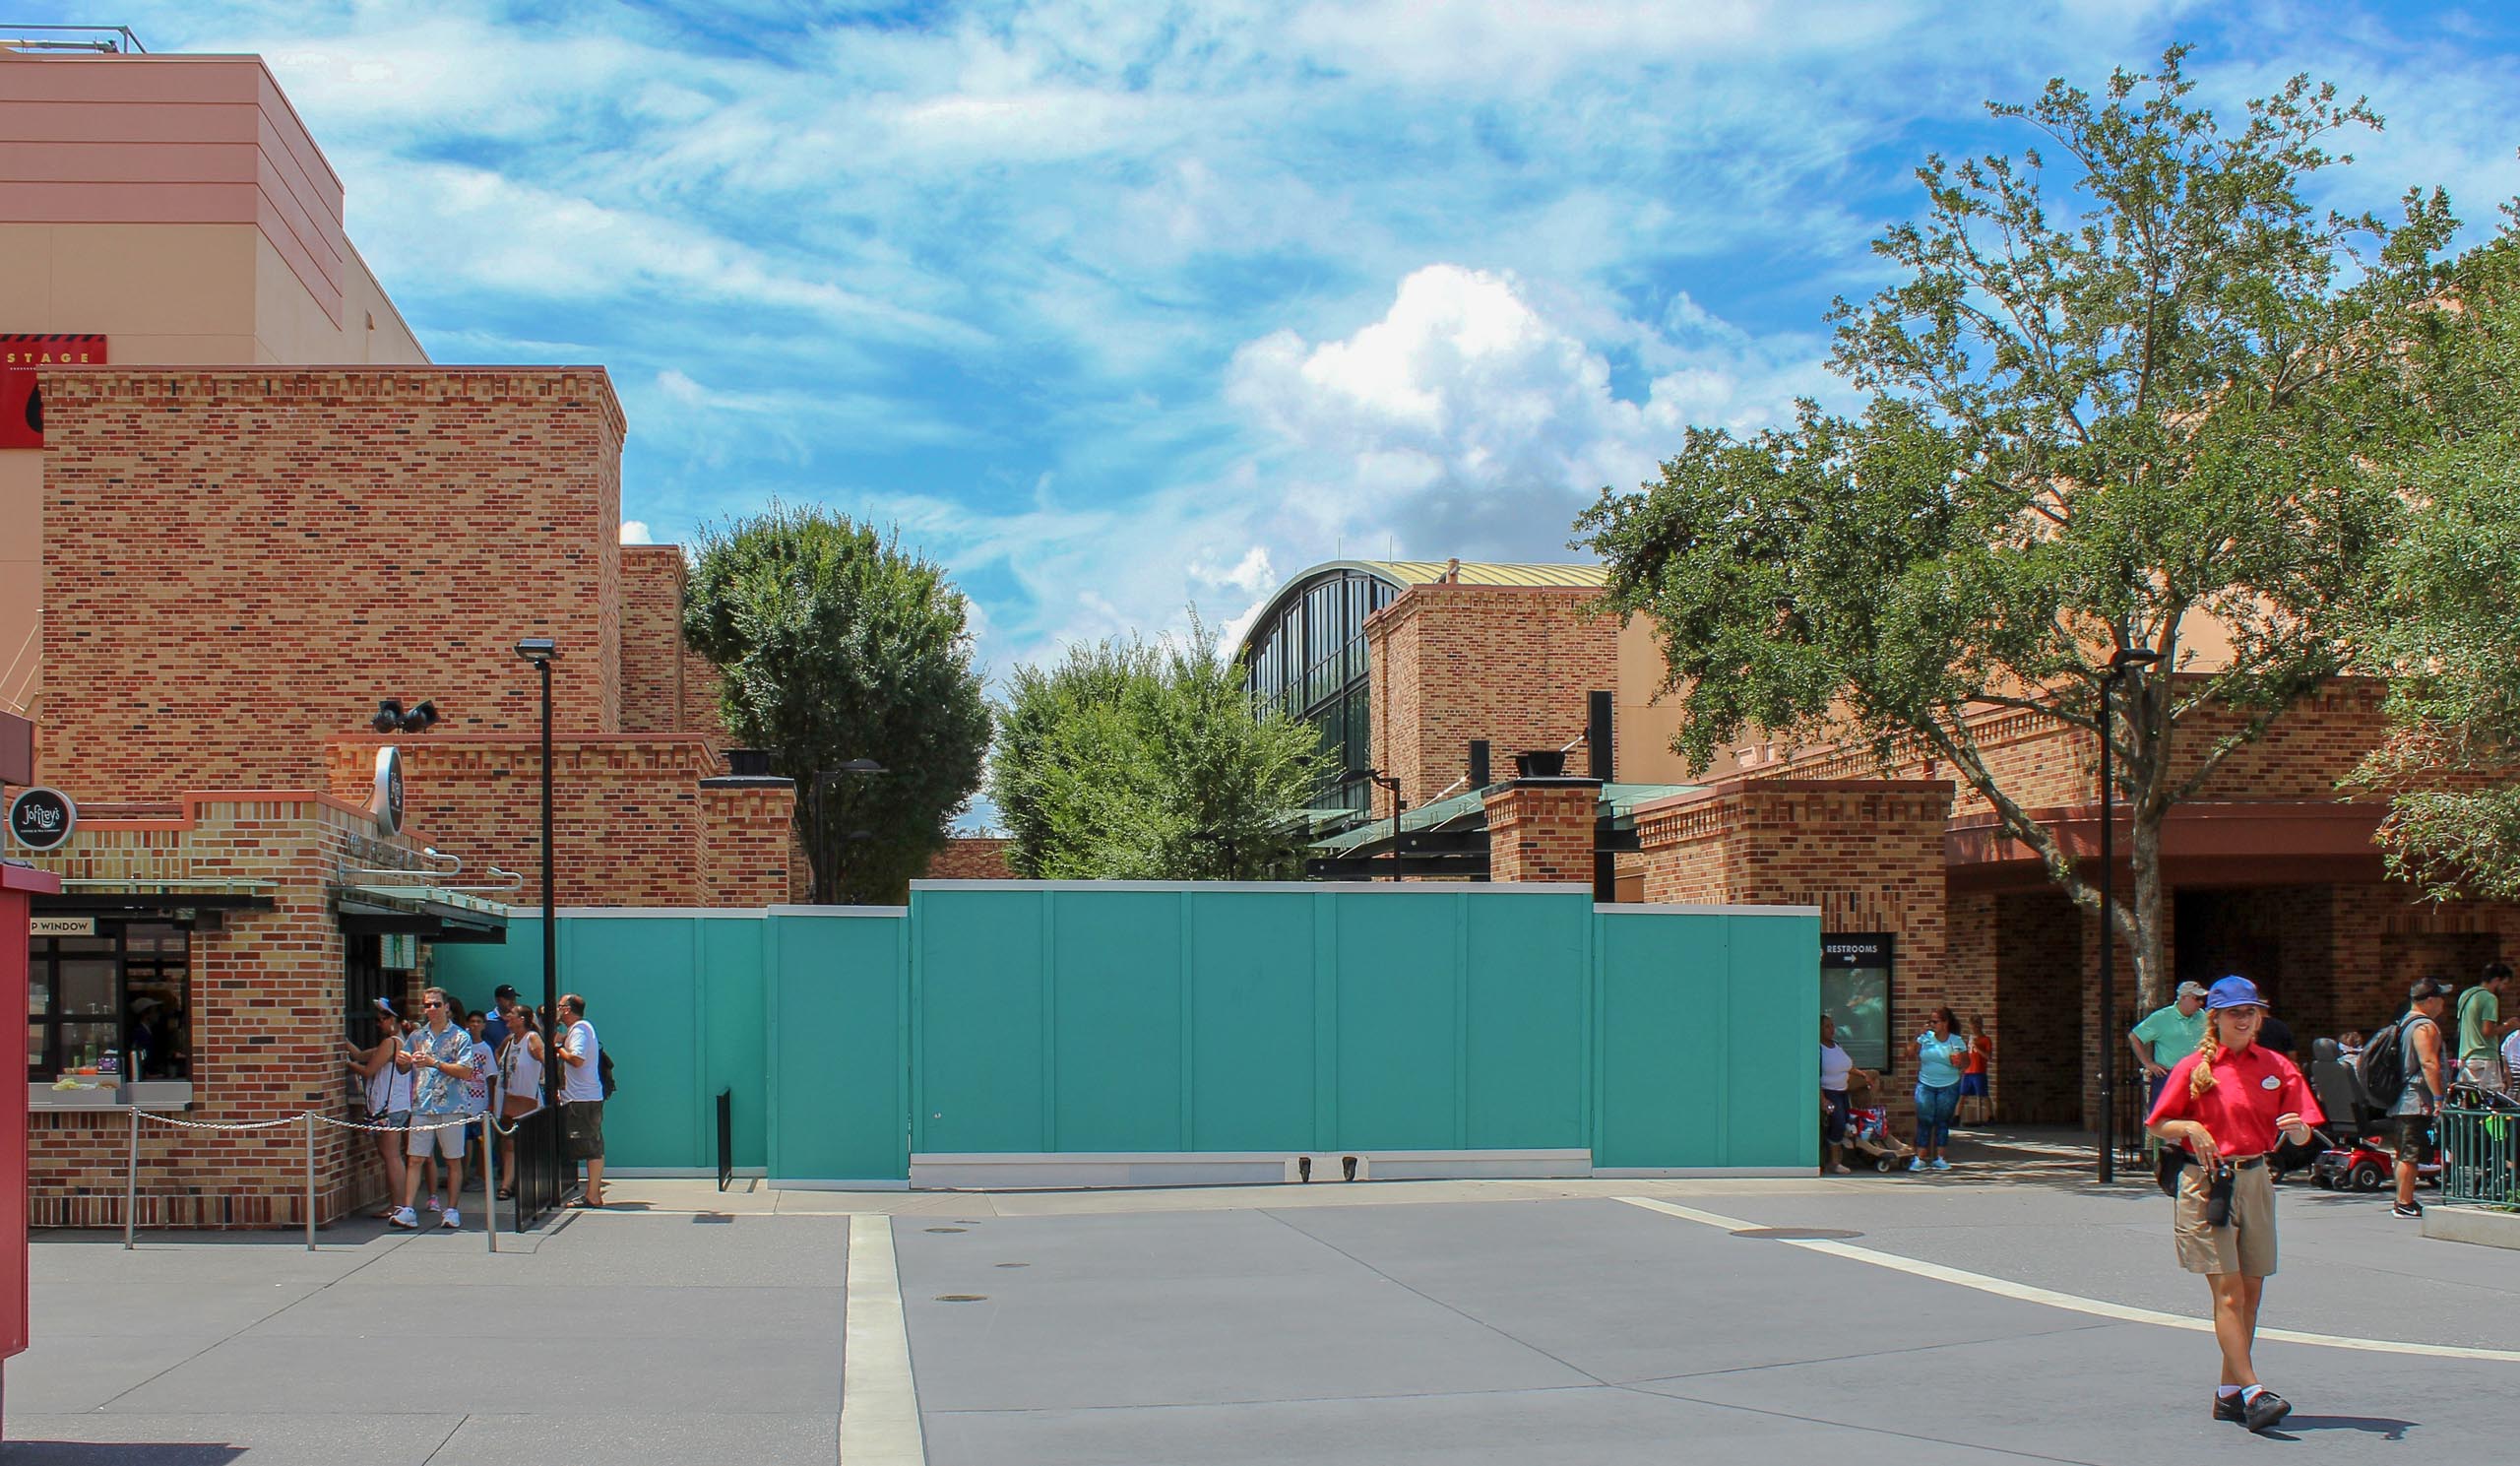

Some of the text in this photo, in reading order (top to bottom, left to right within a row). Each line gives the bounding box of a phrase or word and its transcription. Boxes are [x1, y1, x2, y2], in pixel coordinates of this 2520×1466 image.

[7, 352, 89, 363] STAGE
[22, 803, 60, 828] Joffrey's
[40, 922, 88, 931] WINDOW
[1826, 944, 1878, 953] RESTROOMS
